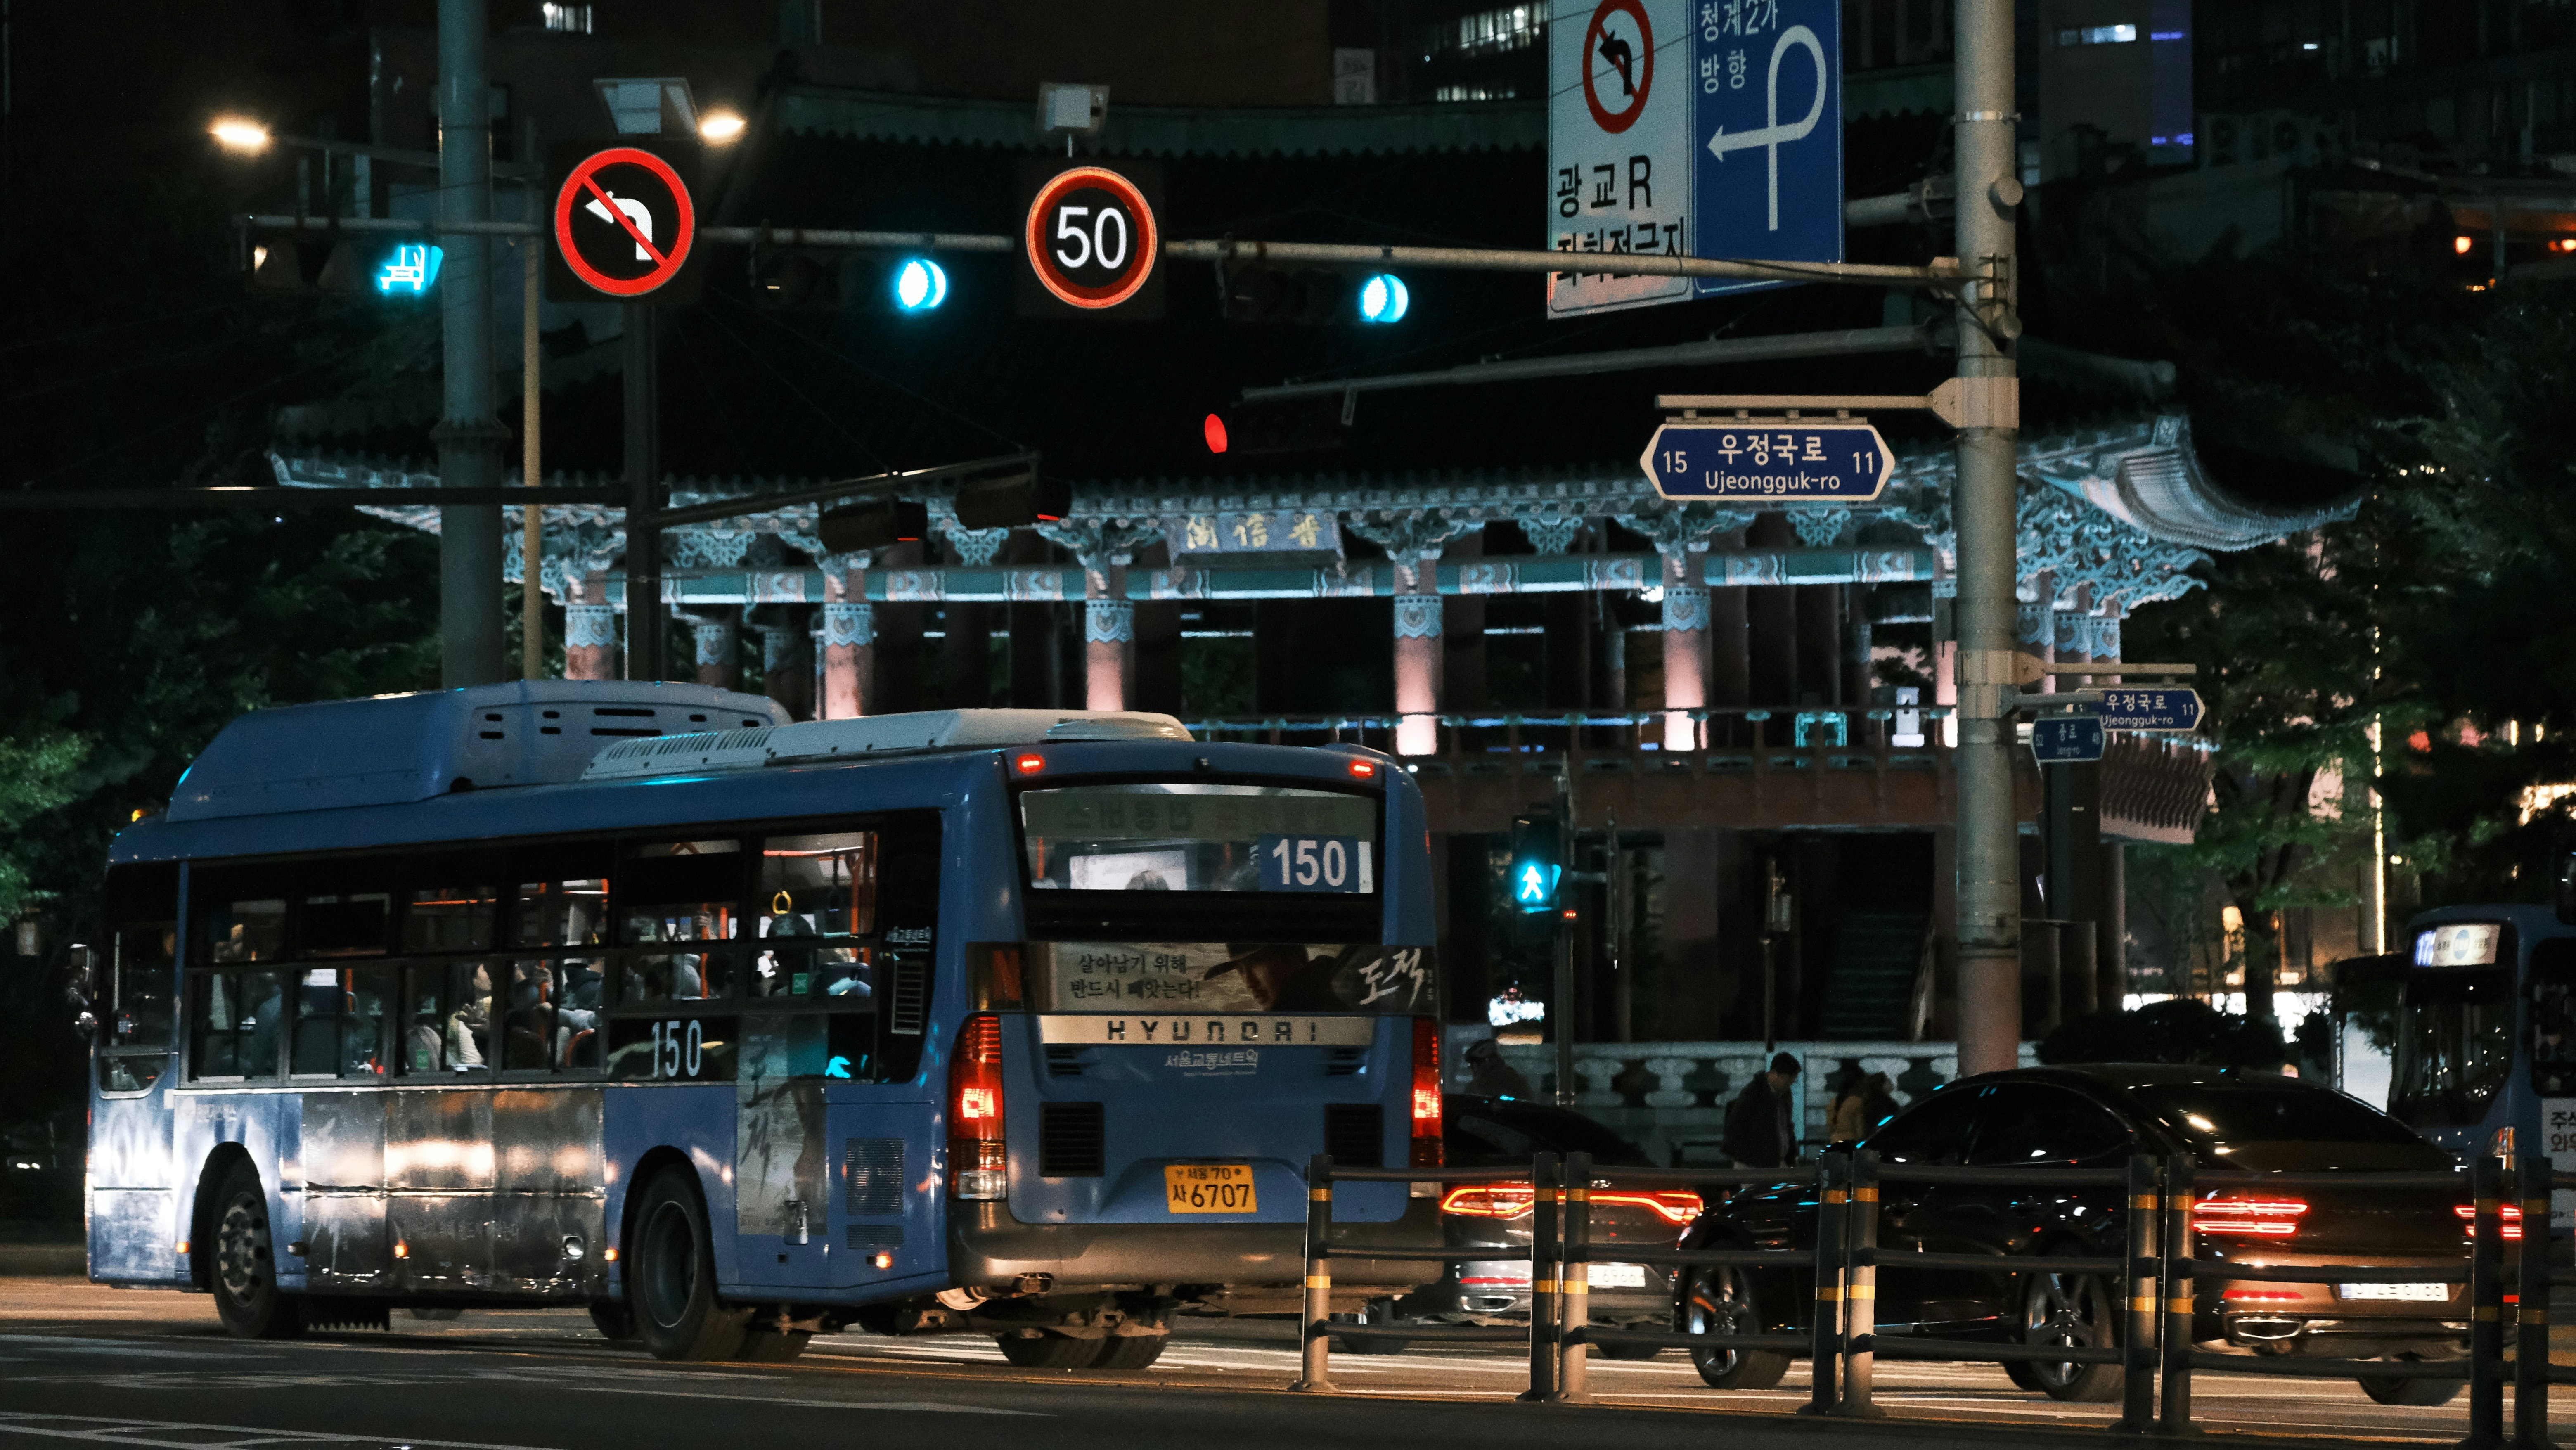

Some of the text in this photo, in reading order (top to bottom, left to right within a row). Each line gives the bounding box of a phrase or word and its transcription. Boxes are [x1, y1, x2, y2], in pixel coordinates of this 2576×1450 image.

[1701, 48, 1747, 94] 방향
[1056, 206, 1127, 269] 50
[1717, 434, 1827, 465] 우정국로
[1662, 451, 1688, 474] 15
[1852, 452, 1873, 474] 11
[1705, 471, 1840, 494] Ujeongguk-ro
[2106, 694, 2167, 712] 우정국로
[2182, 704, 2194, 716] 11
[2100, 715, 2174, 728] Ujeongguk-ro
[1272, 839, 1347, 887] 150
[1079, 954, 1186, 974] 살아남기 위해
[1070, 979, 1120, 999] 반드시
[1358, 948, 1424, 1010] 도적
[1108, 1020, 1316, 1042] HYUNDAI
[652, 1020, 702, 1077] 150
